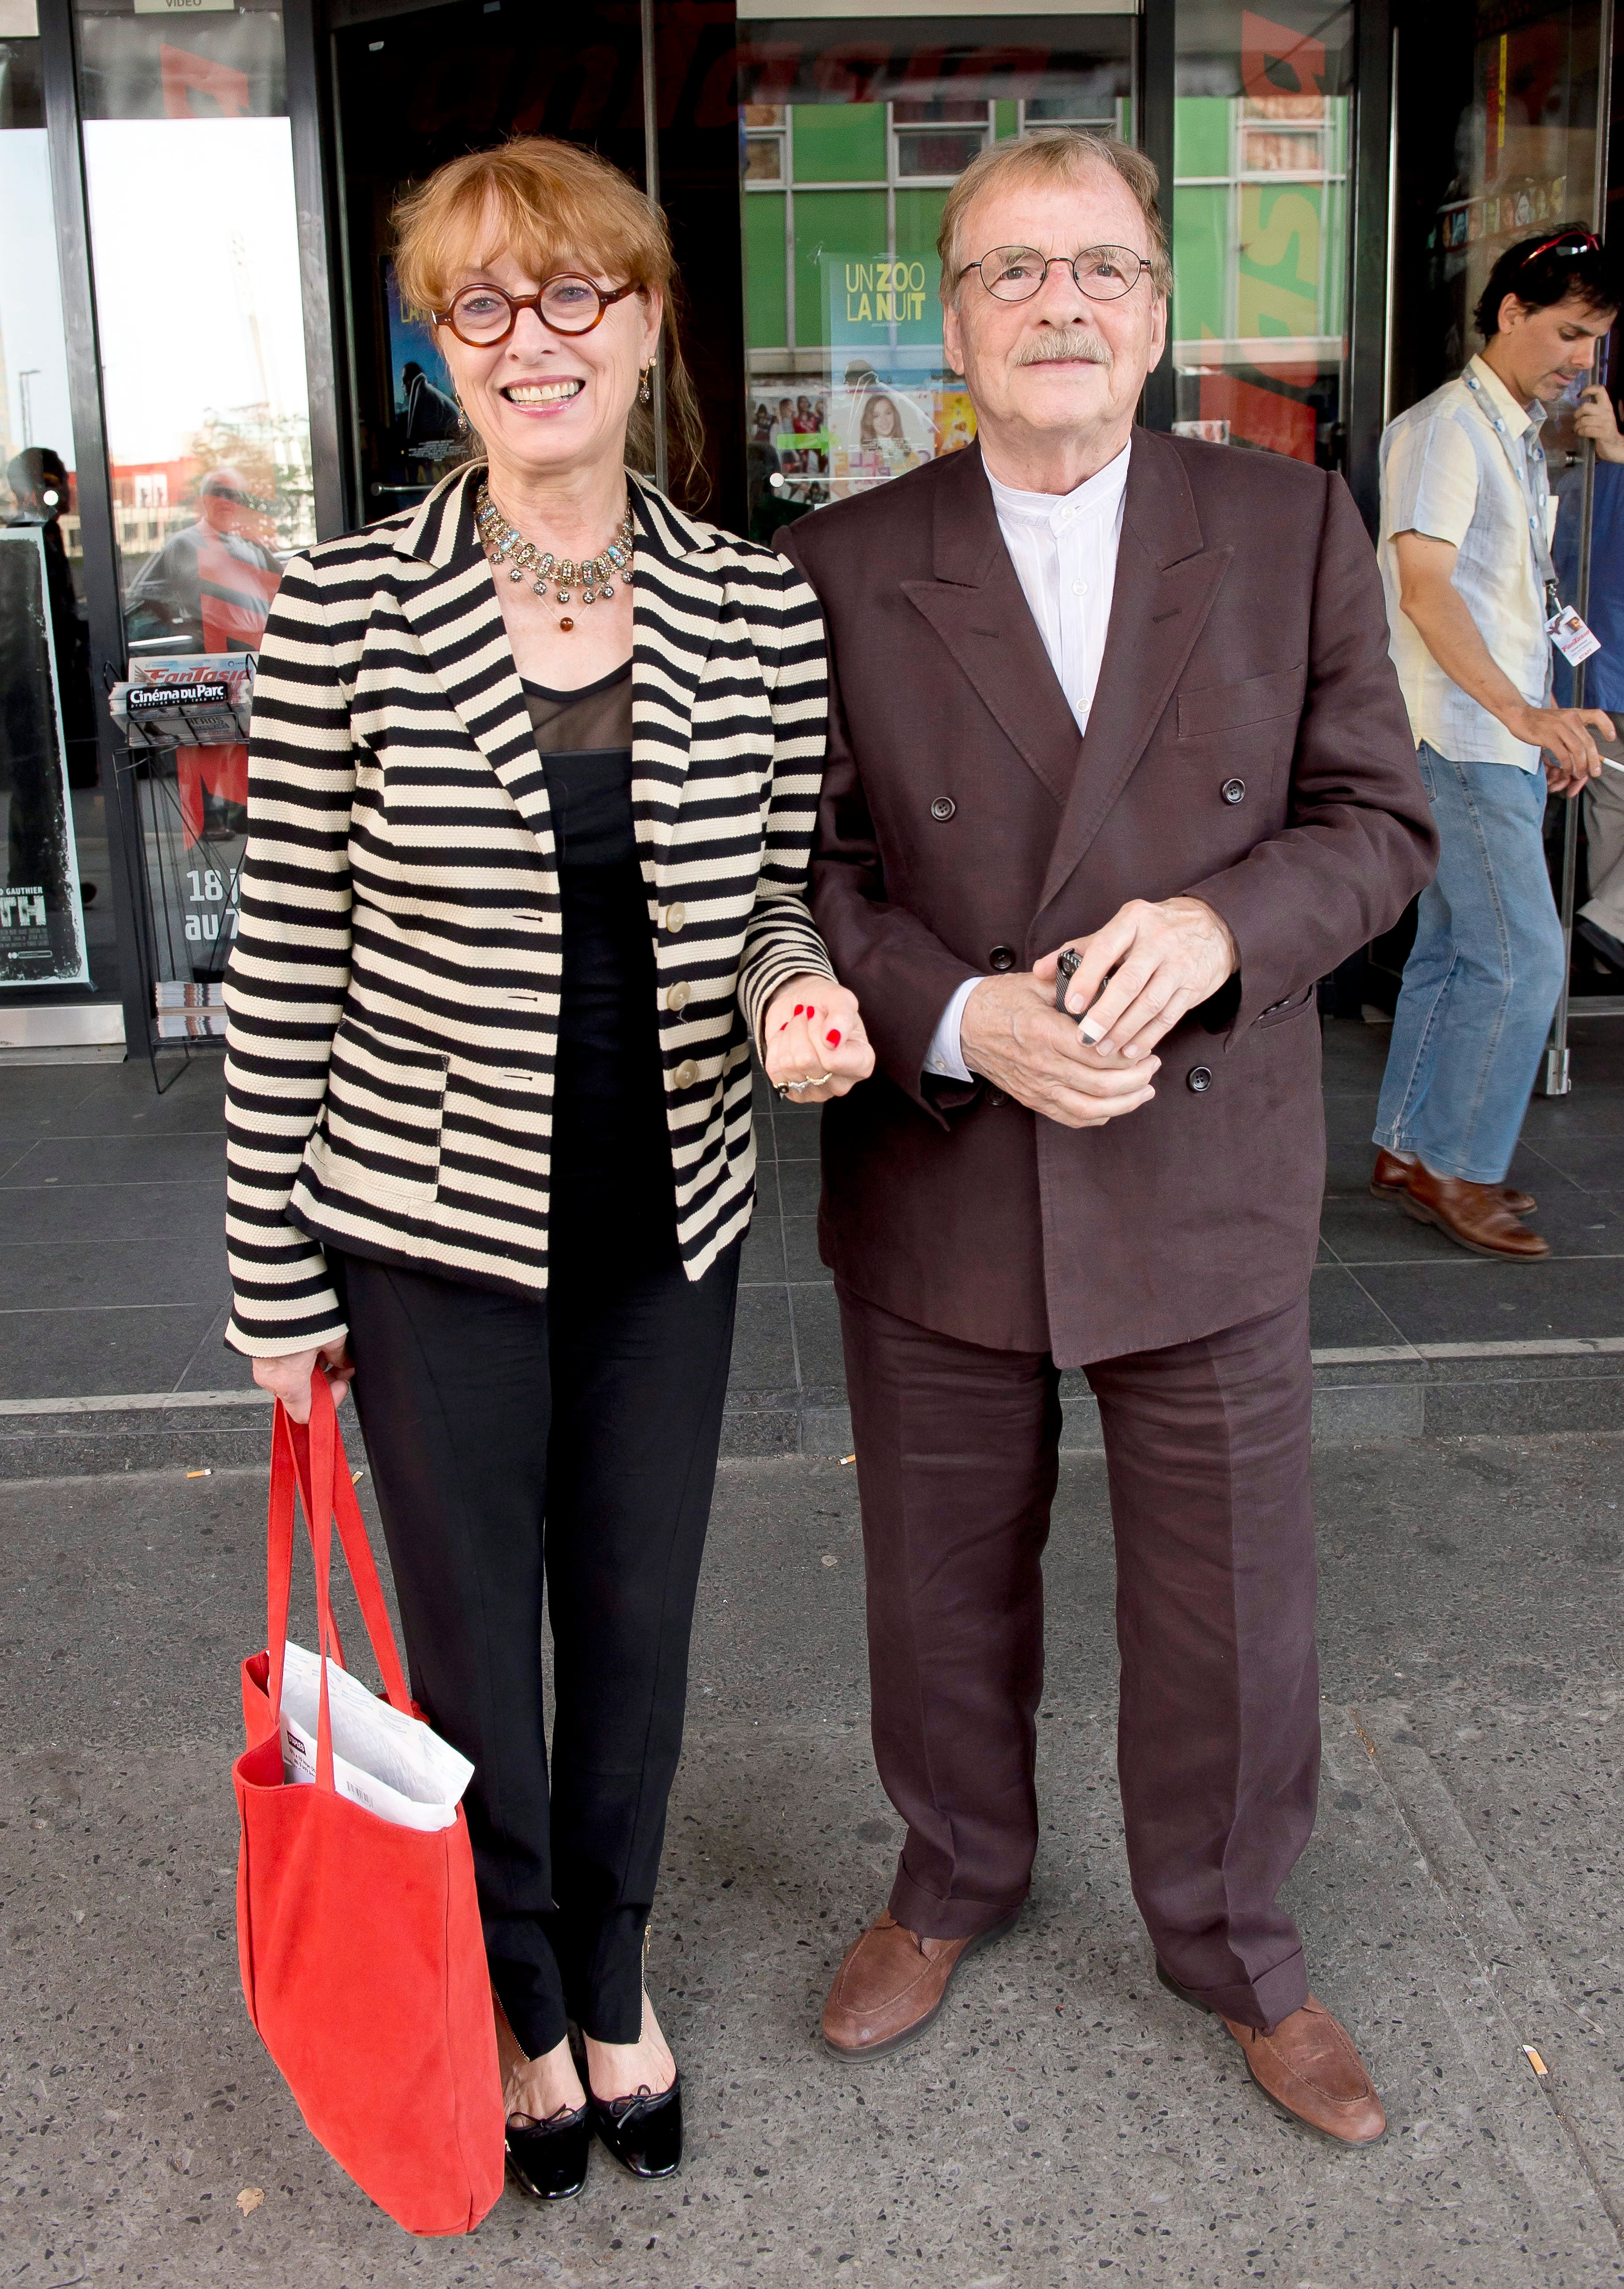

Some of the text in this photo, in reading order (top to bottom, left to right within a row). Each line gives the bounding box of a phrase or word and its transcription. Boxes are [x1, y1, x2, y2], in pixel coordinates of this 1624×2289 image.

[846, 262, 926, 293] UN ZOO
[847, 291, 926, 322] LA NUIT
[130, 688, 179, 703] Cinéma
[196, 684, 224, 697] Parc
[6, 886, 43, 895] GAUTHIER
[186, 869, 223, 901] 18
[185, 914, 220, 941] au
